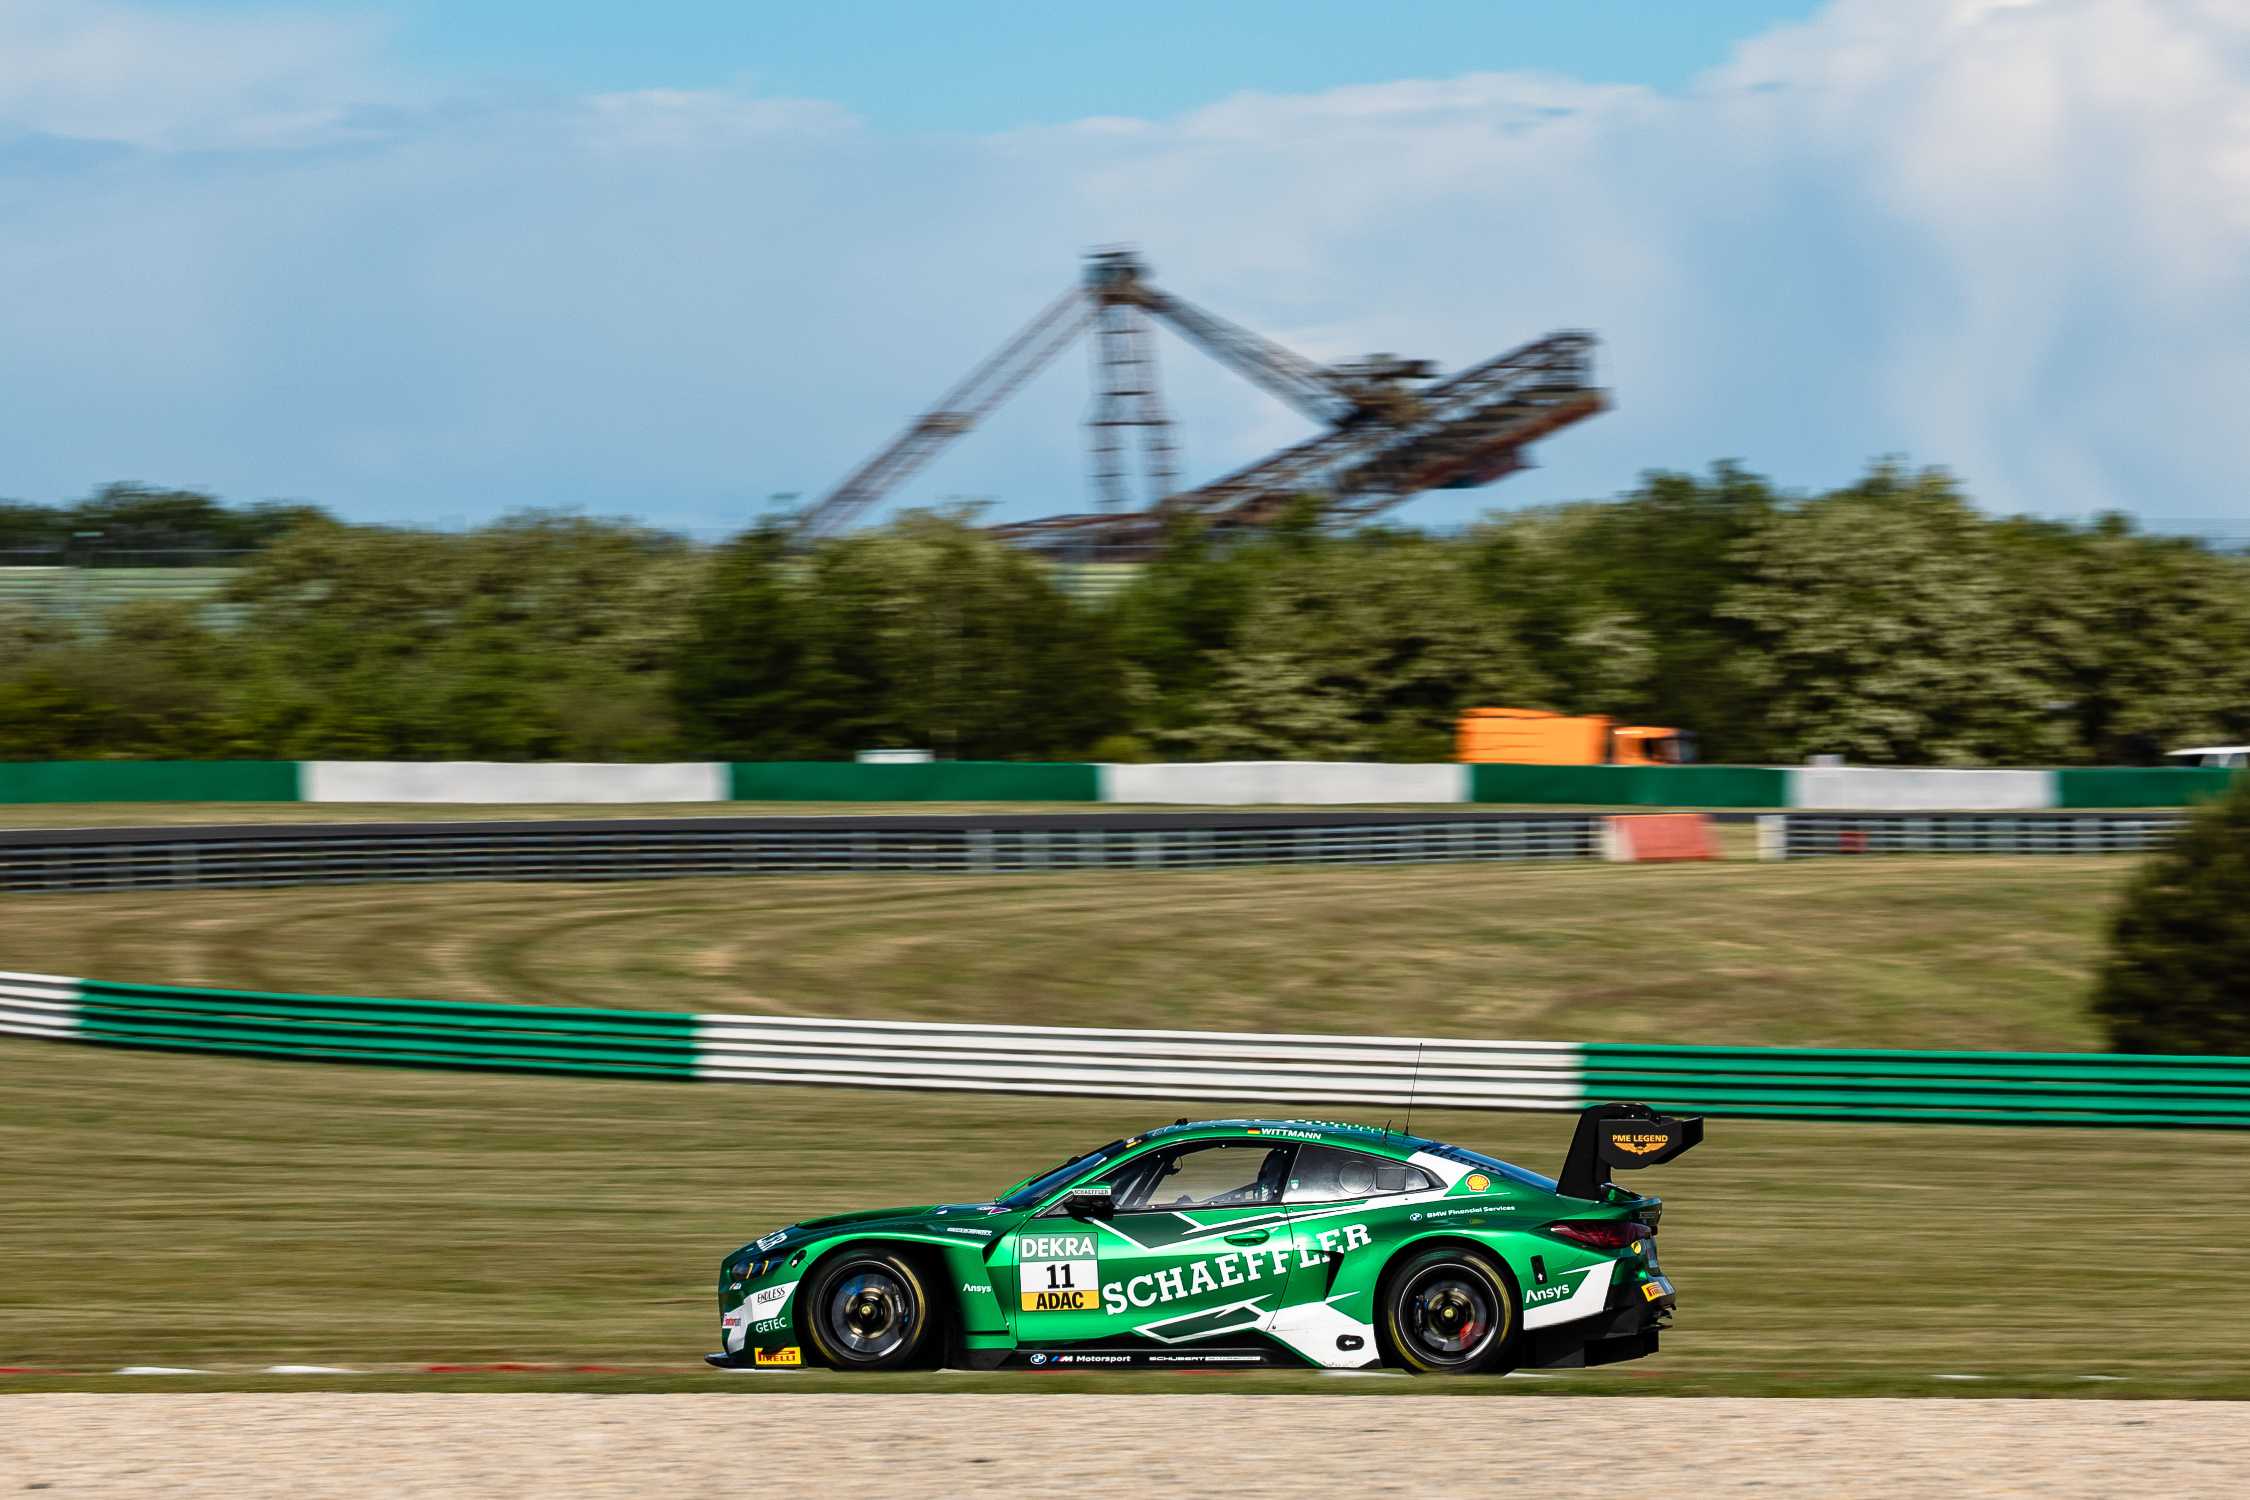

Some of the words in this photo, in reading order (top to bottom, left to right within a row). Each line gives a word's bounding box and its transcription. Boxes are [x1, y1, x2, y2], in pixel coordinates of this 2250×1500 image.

[1261, 1128, 1322, 1139] WITTMANN
[1426, 1211, 1447, 1219] BMW
[1448, 1207, 1482, 1216] Financial
[1021, 1237, 1096, 1257] DEKRA
[1046, 1263, 1075, 1289] 11
[1102, 1223, 1371, 1315] SCHAEFFLER
[757, 1287, 786, 1303] ENDLESS
[963, 1283, 992, 1294] Ansys
[1525, 1284, 1570, 1304] Ansys
[1036, 1292, 1084, 1310] ADAC
[755, 1317, 787, 1333] GETEC
[1076, 1355, 1131, 1363] Motorsport
